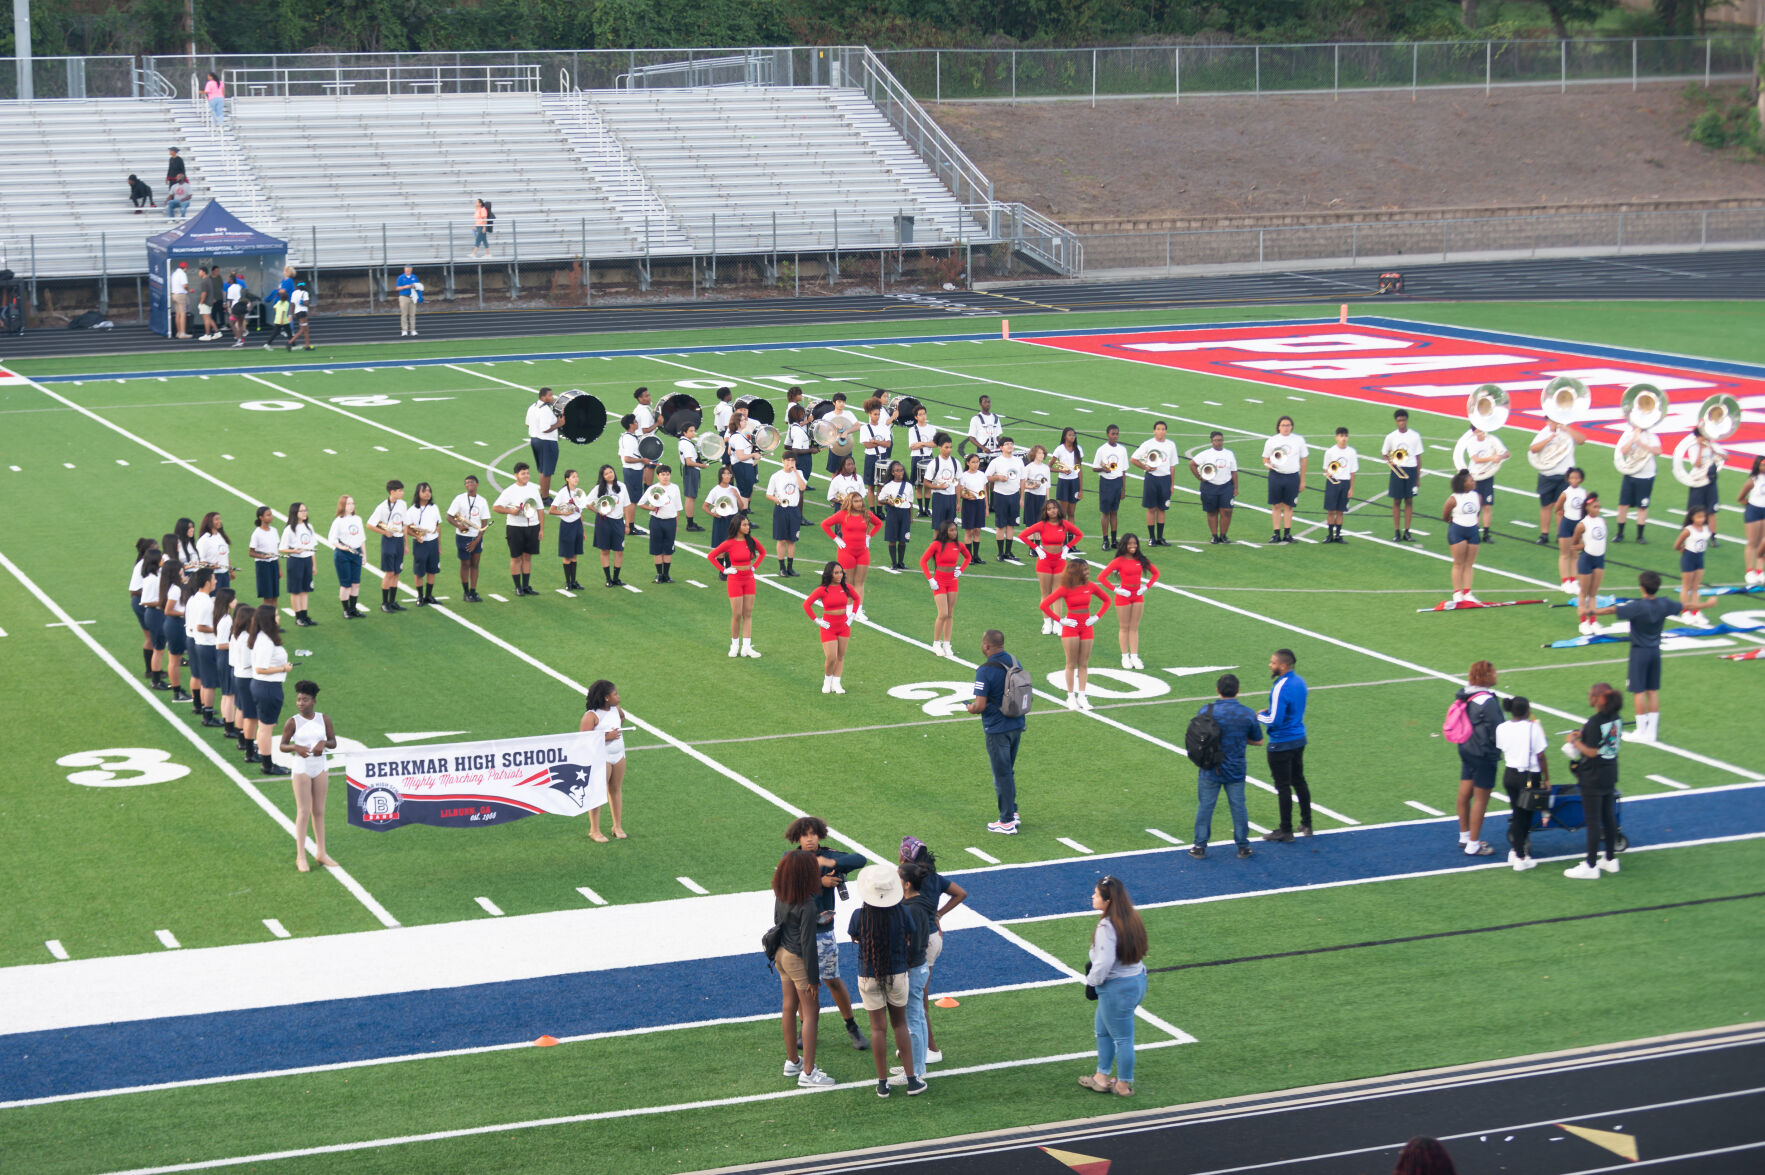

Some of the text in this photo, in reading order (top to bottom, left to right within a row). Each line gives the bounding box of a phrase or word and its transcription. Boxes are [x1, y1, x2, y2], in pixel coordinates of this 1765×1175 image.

[365, 747, 568, 778] BERKMAR HIGH SCHOOL
[402, 767, 524, 791] Mighty Marching Patriots
[373, 796, 389, 814] B
